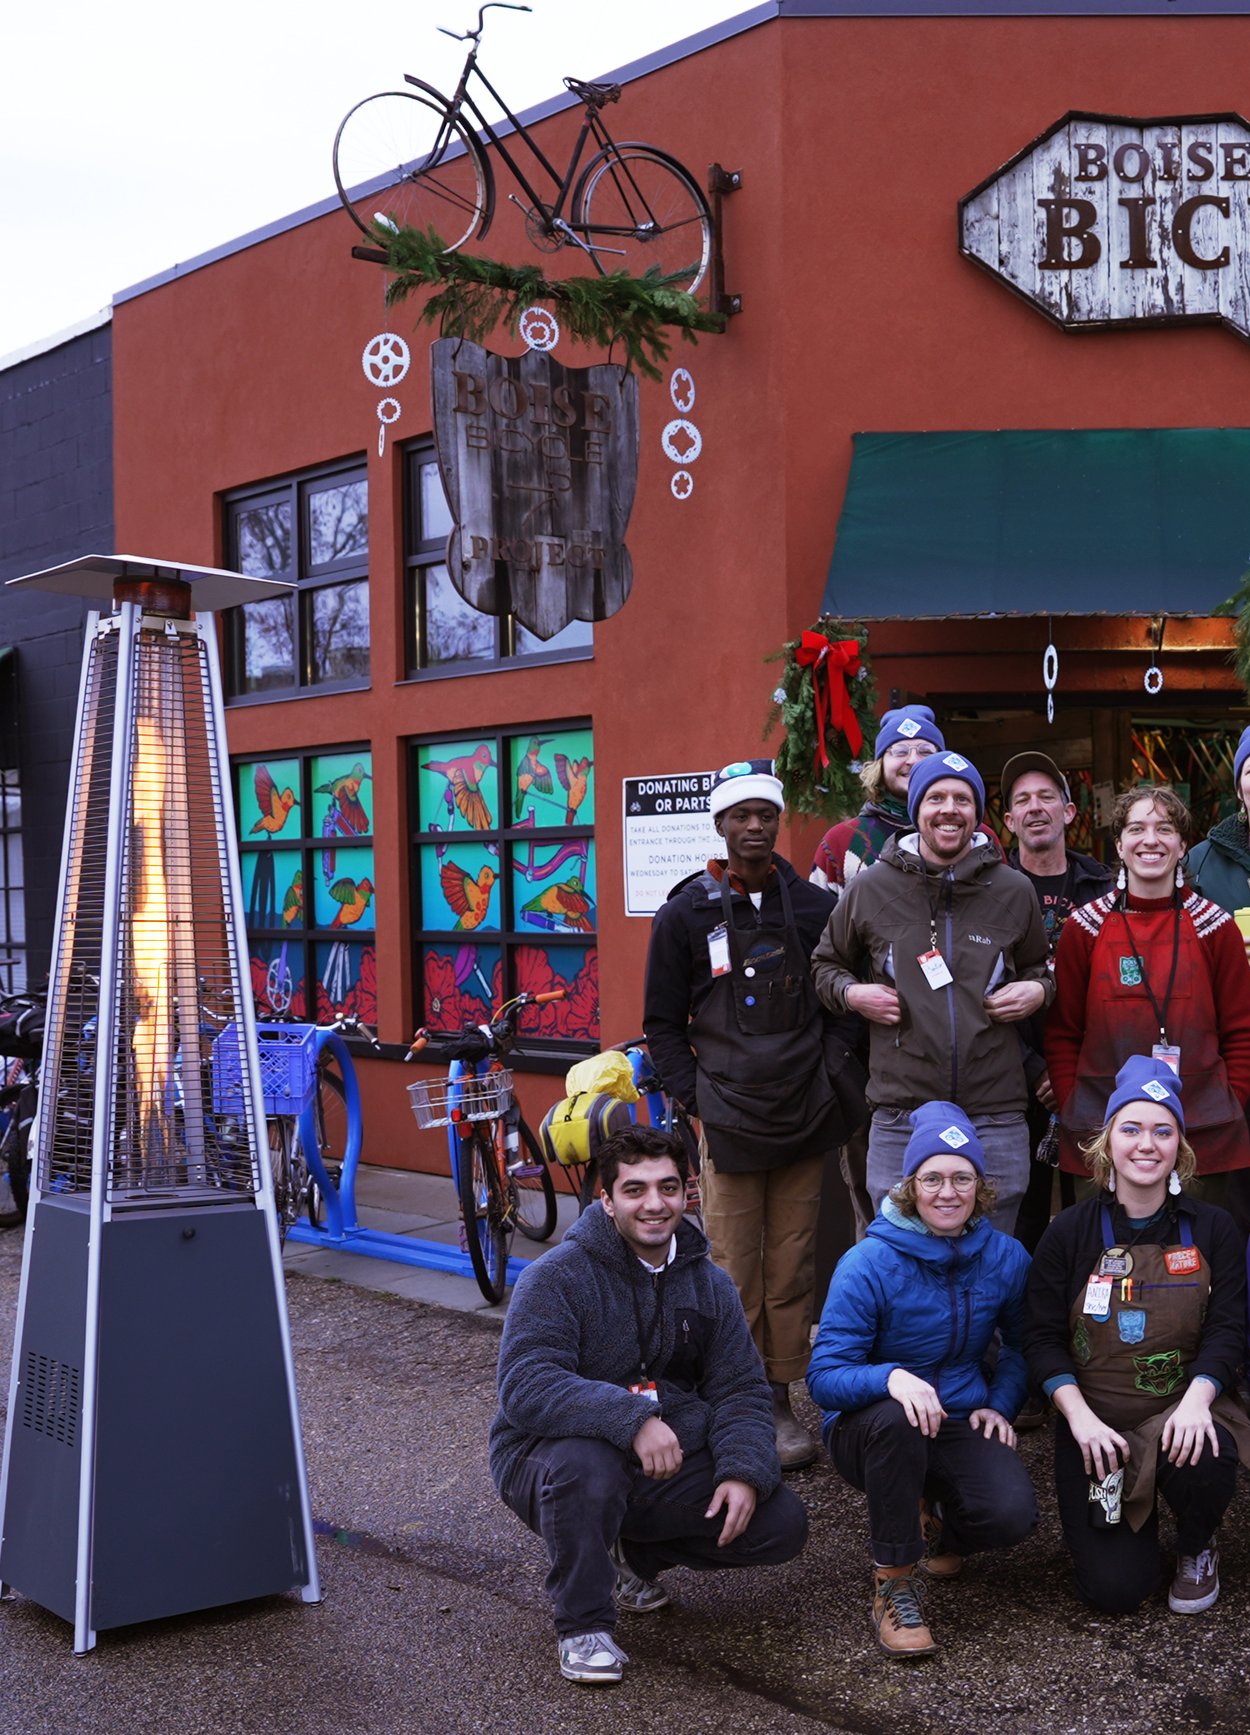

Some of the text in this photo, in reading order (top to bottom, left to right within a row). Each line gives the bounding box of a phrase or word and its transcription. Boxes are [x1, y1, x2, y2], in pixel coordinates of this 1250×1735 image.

[452, 370, 612, 434] BOISE
[471, 535, 607, 573] PROJECT
[638, 778, 698, 795] DONATING
[655, 799, 672, 812] OR
[630, 826, 646, 834] TAKE
[648, 825, 659, 833] ALL
[662, 823, 700, 832] DONATIONS
[629, 838, 662, 846] ENTRANCE
[648, 854, 691, 864] DONATION
[630, 869, 668, 877] WEDNESDAY
[670, 868, 678, 876] TO
